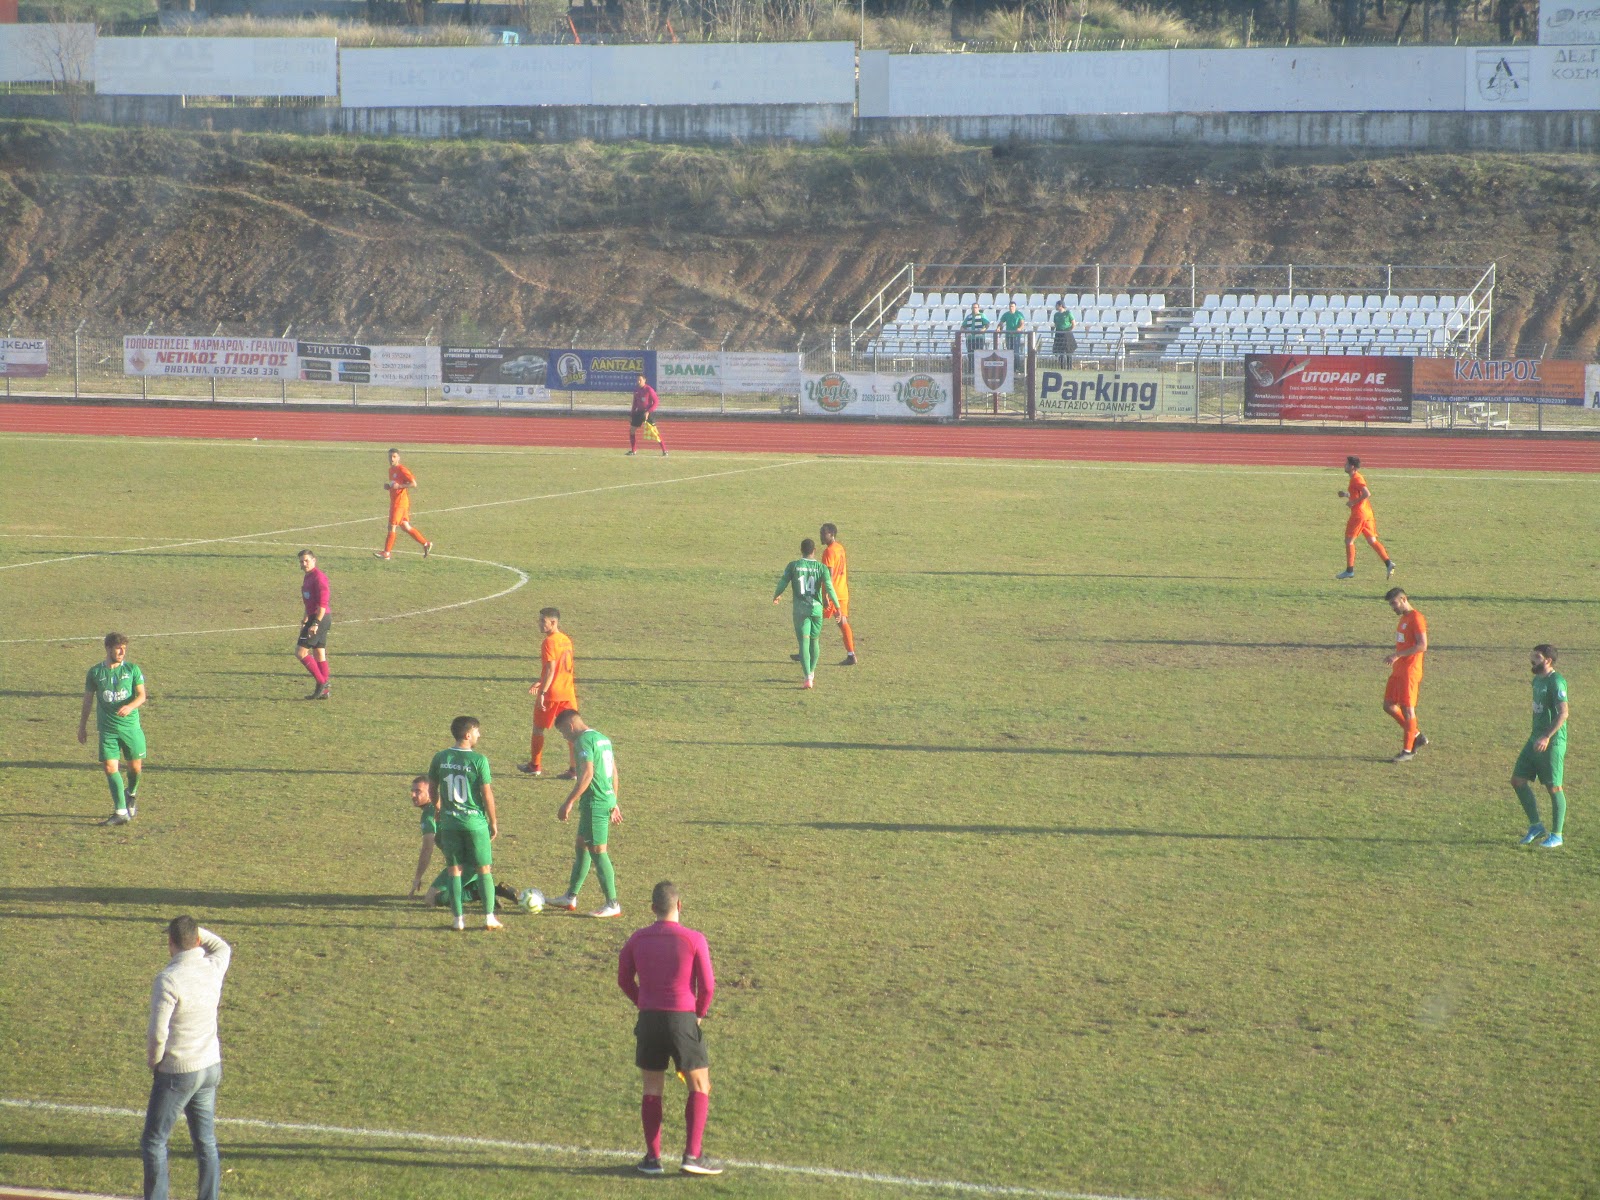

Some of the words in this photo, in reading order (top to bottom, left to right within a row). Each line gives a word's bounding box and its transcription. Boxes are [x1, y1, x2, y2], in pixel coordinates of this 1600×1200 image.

[125, 338, 190, 350] ΤΟΠΟΘΕΤΗΣΕΙΣ
[193, 339, 244, 352] ΜΑΡΜΑΡΩΝ
[251, 340, 295, 353] ΓΡΑΝΙΤΩΝ
[307, 345, 362, 356] ΣΤΡΑΤΕΛΟΣ
[155, 351, 218, 364] ΝΕΤΙΚΟΣ
[224, 353, 289, 366] ΓΙΩΡΓΟΣ
[591, 358, 644, 372] ΛΑΝΤΖΑΣ
[213, 366, 237, 375] 6972
[240, 366, 259, 375] 549
[262, 367, 280, 376] 336
[1454, 359, 1542, 381] ΚΑΠΡΟΣ
[805, 379, 858, 403] Voglis
[893, 381, 947, 405] Voglis
[1040, 371, 1158, 411] Parking
[1039, 399, 1095, 411] ΑΝΑΣΤΑΣΙΟΥ
[1096, 401, 1136, 412] ΙΩΑΝΝΗΣ
[798, 575, 815, 595] 14
[440, 762, 461, 771] RODOS
[443, 773, 468, 804] 10
